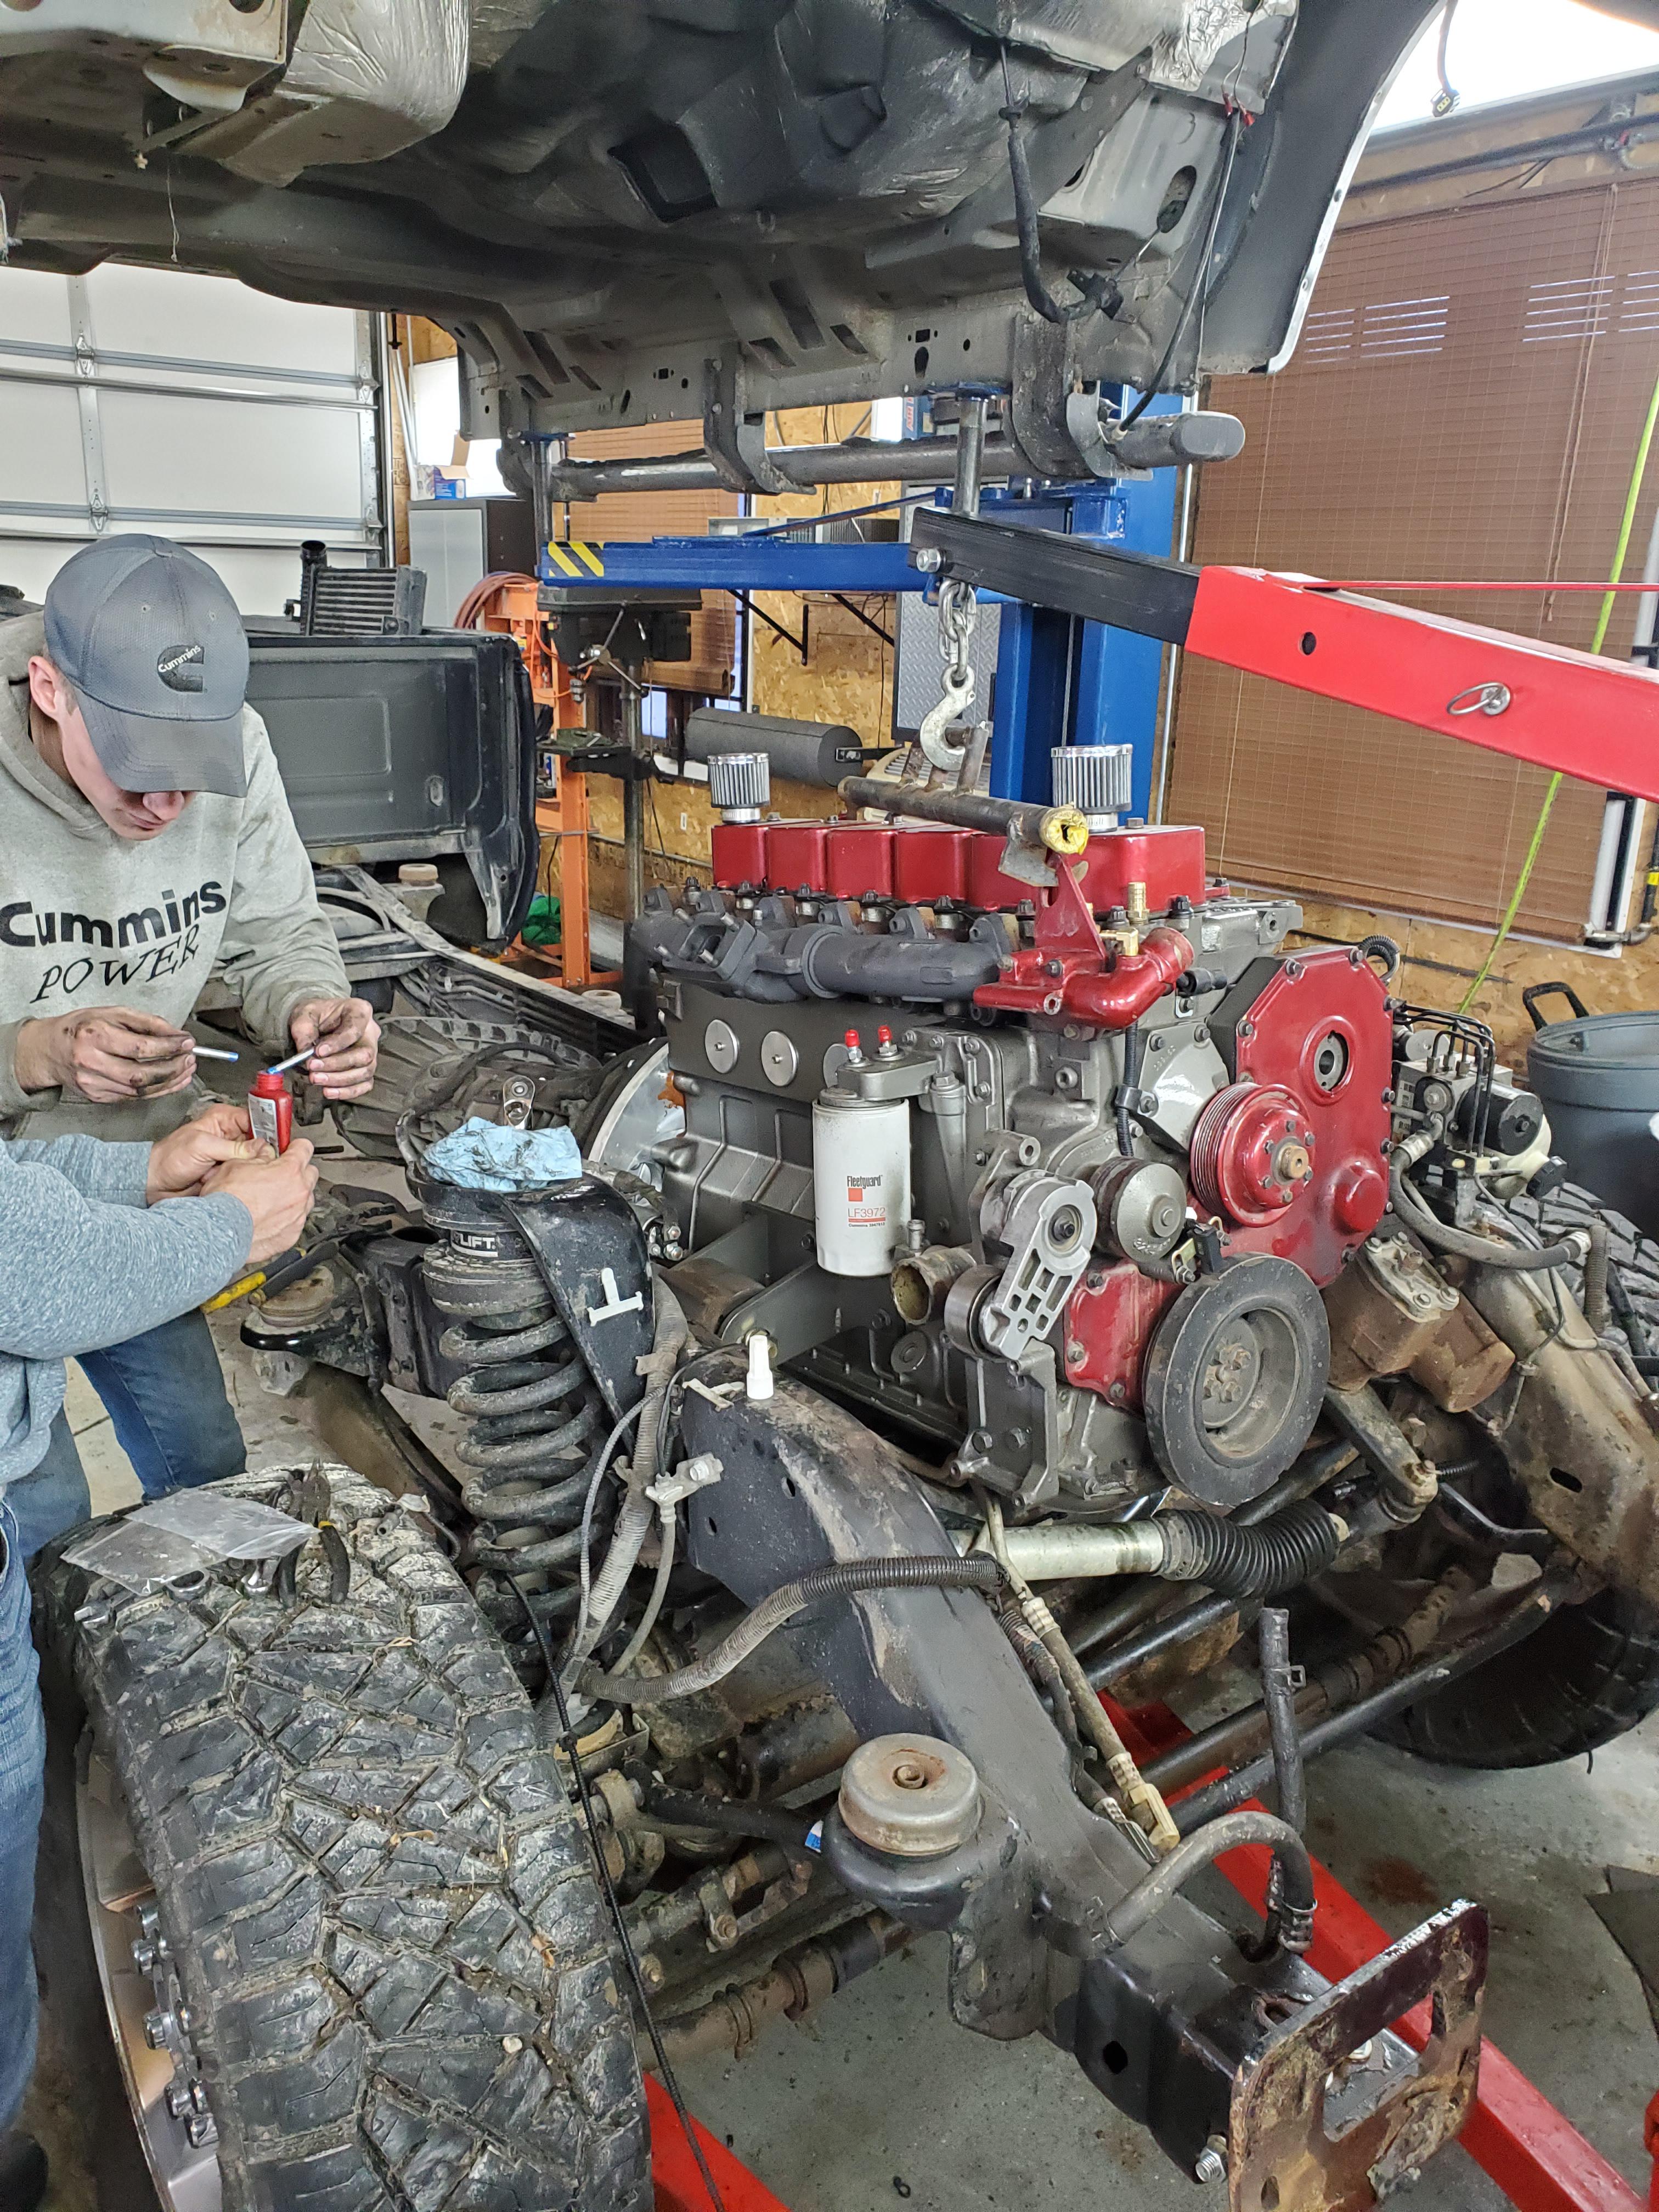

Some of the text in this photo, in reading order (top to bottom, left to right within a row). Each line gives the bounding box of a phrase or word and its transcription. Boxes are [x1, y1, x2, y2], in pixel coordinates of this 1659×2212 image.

[157, 645, 201, 673] Cummins
[0, 881, 227, 949] Cummins
[30, 923, 200, 1004] POWER
[847, 1175, 881, 1189] Fleetguard
[848, 1207, 885, 1217] LF3972
